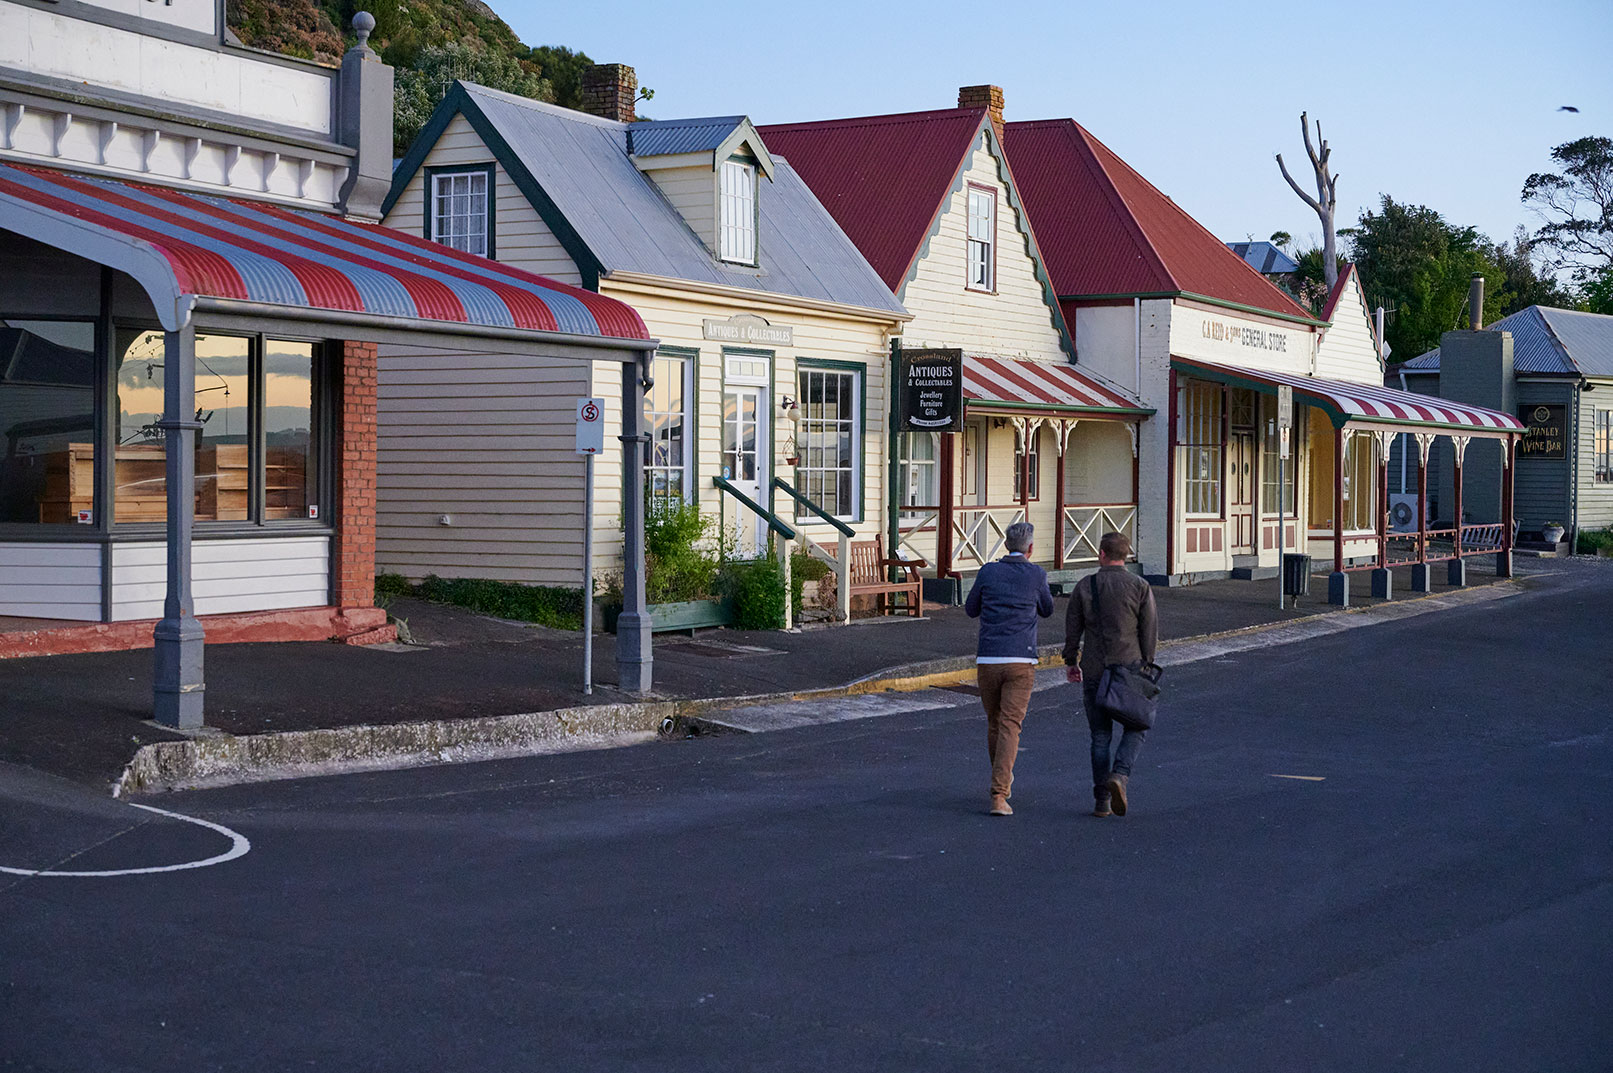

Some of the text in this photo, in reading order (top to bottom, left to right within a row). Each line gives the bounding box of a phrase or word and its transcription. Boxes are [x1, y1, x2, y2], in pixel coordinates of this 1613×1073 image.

[708, 322, 791, 342] ANTIQUES & COLLECTABLES
[1242, 327, 1268, 349] GENERAL
[1269, 332, 1287, 352] STORE
[908, 364, 953, 379] ANTIQUES
[915, 378, 953, 386] COLLECTABLES
[920, 391, 943, 400] Jewellery
[920, 399, 943, 407] Furniture
[924, 408, 938, 416] Gifts
[1526, 425, 1559, 437] STANLEY
[1522, 439, 1562, 453] WINE BAR
